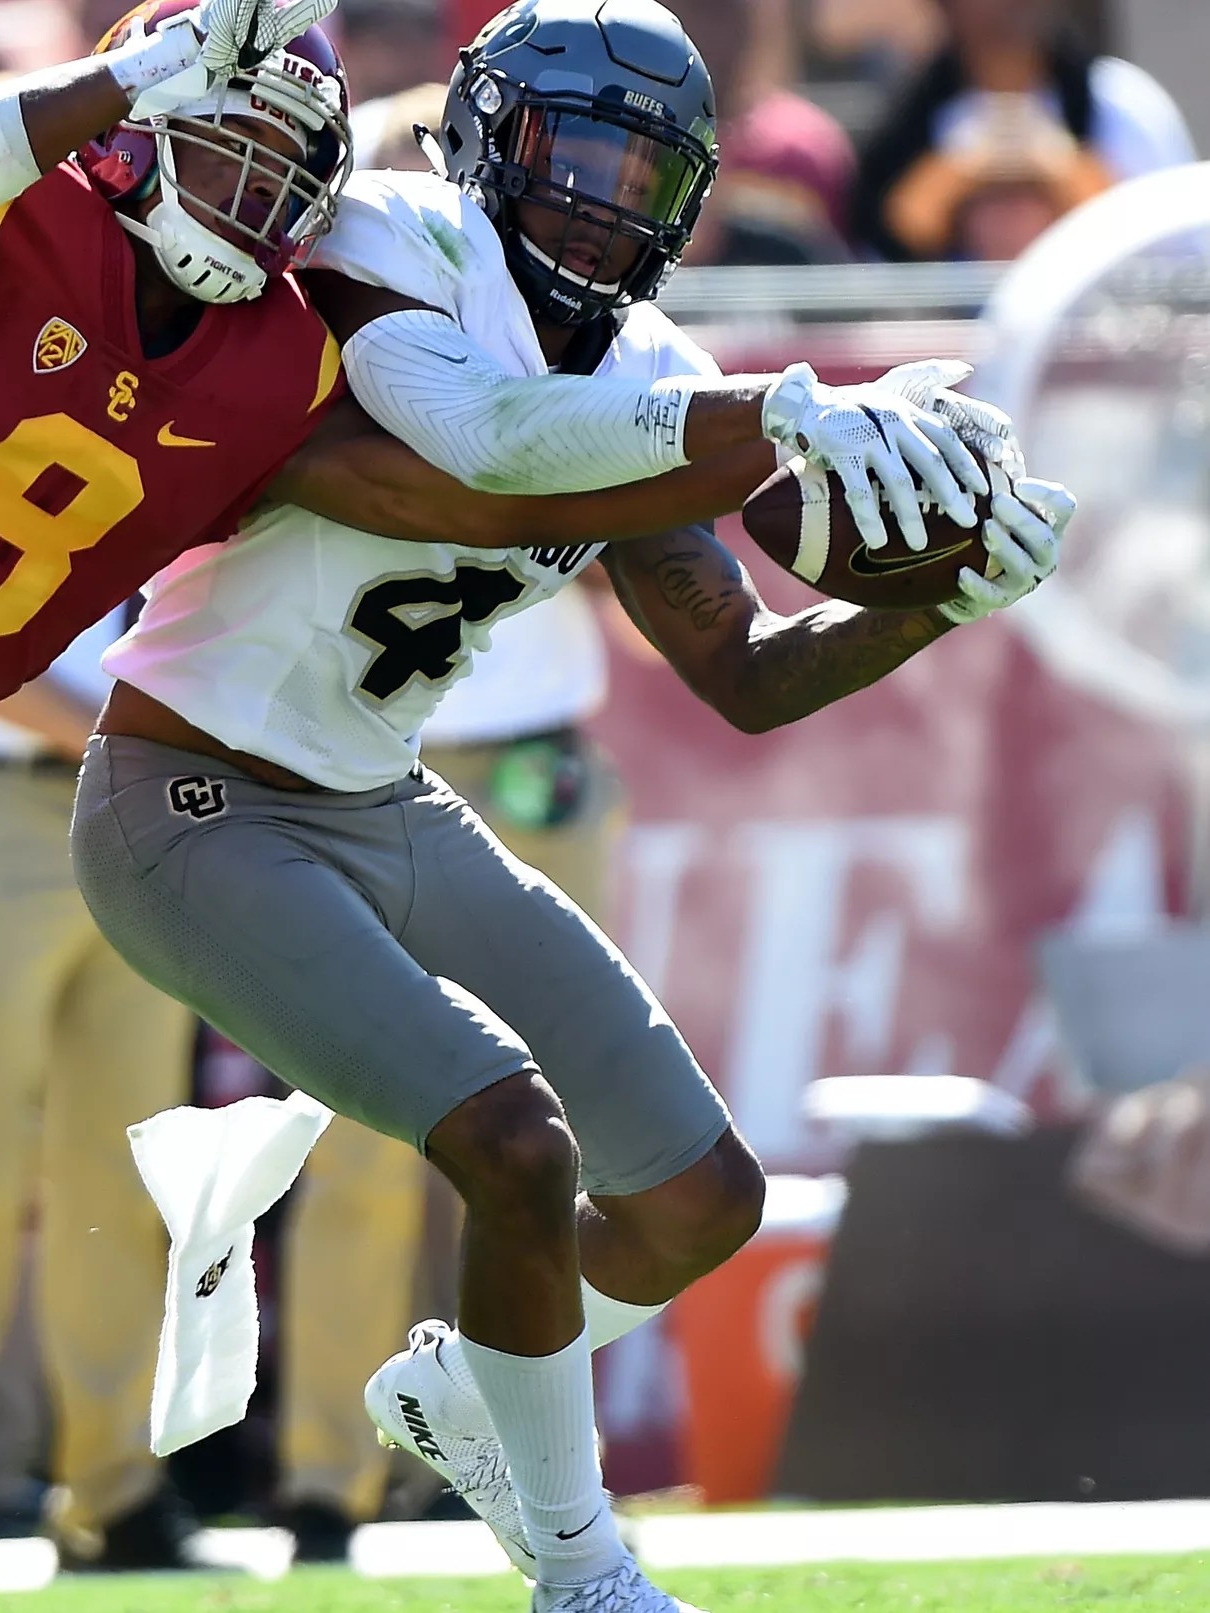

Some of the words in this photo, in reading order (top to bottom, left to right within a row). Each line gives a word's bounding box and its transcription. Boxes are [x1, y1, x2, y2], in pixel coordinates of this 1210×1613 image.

[623, 90, 665, 117] BUFFS
[204, 255, 232, 276] FIGHT
[549, 288, 583, 311] Riddell
[341, 557, 538, 710] 4
[395, 1391, 450, 1462] NIKE
